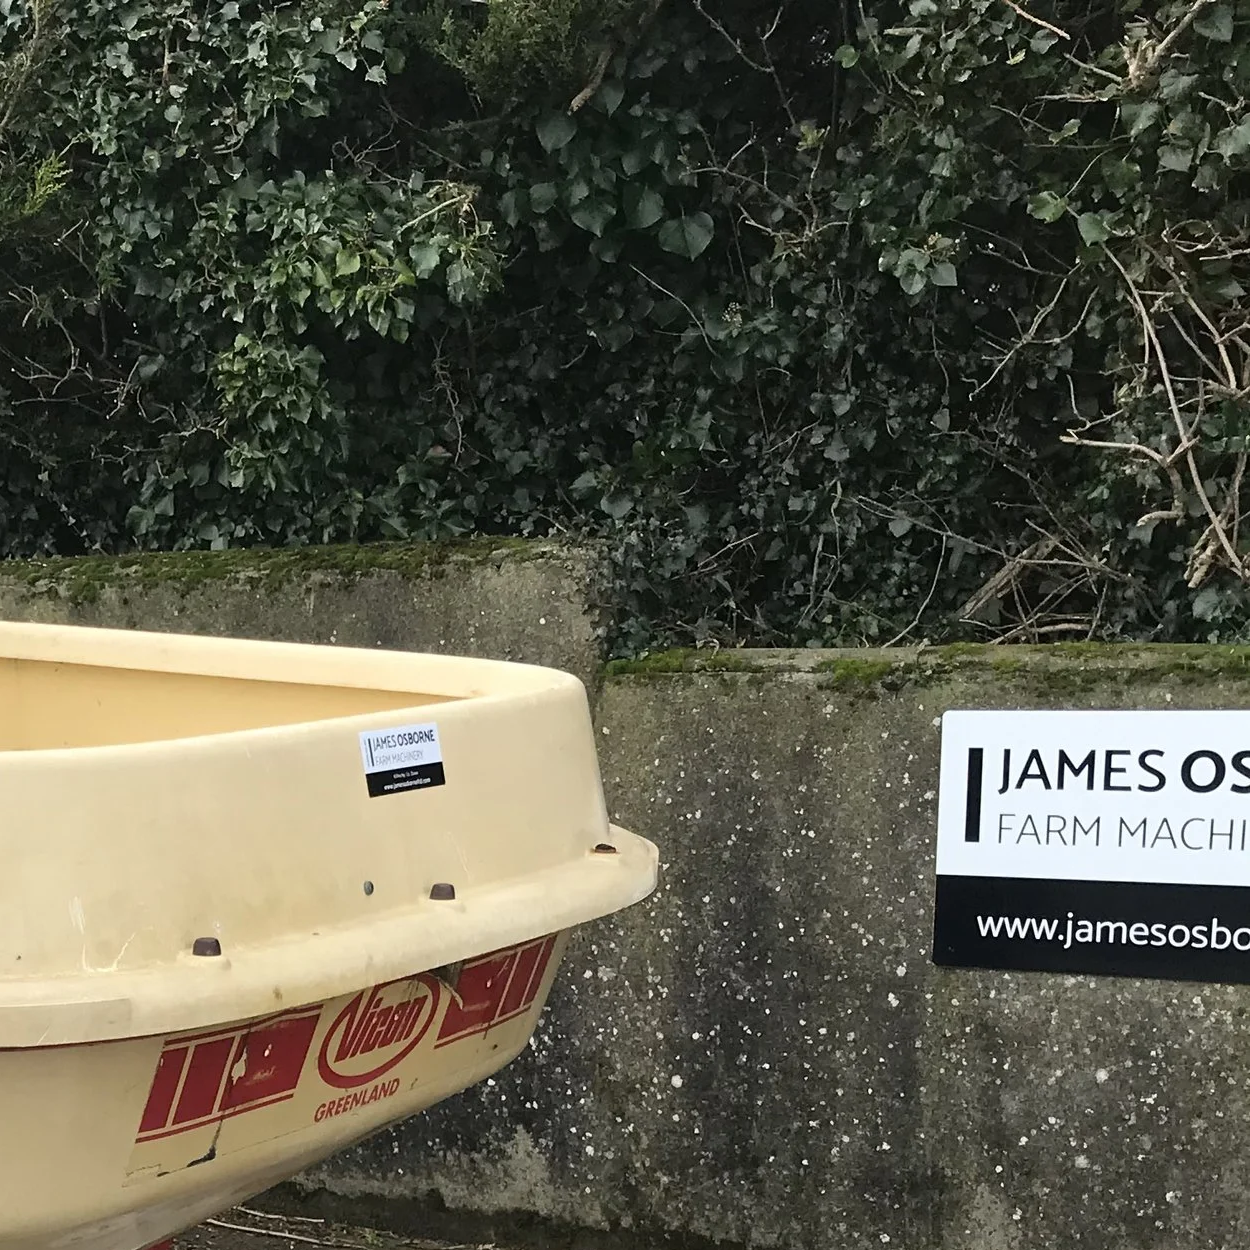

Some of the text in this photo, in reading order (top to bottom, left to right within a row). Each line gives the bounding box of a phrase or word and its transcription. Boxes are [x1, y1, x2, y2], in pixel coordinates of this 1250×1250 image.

[372, 730, 435, 751] JAMES OSBORNE
[998, 748, 1250, 795] JAMES OS
[997, 813, 1247, 851] FARM MACHI
[976, 911, 1250, 951] www.jamesosbo
[333, 985, 429, 1064] Vicon
[314, 1078, 400, 1123] GREENLAND
